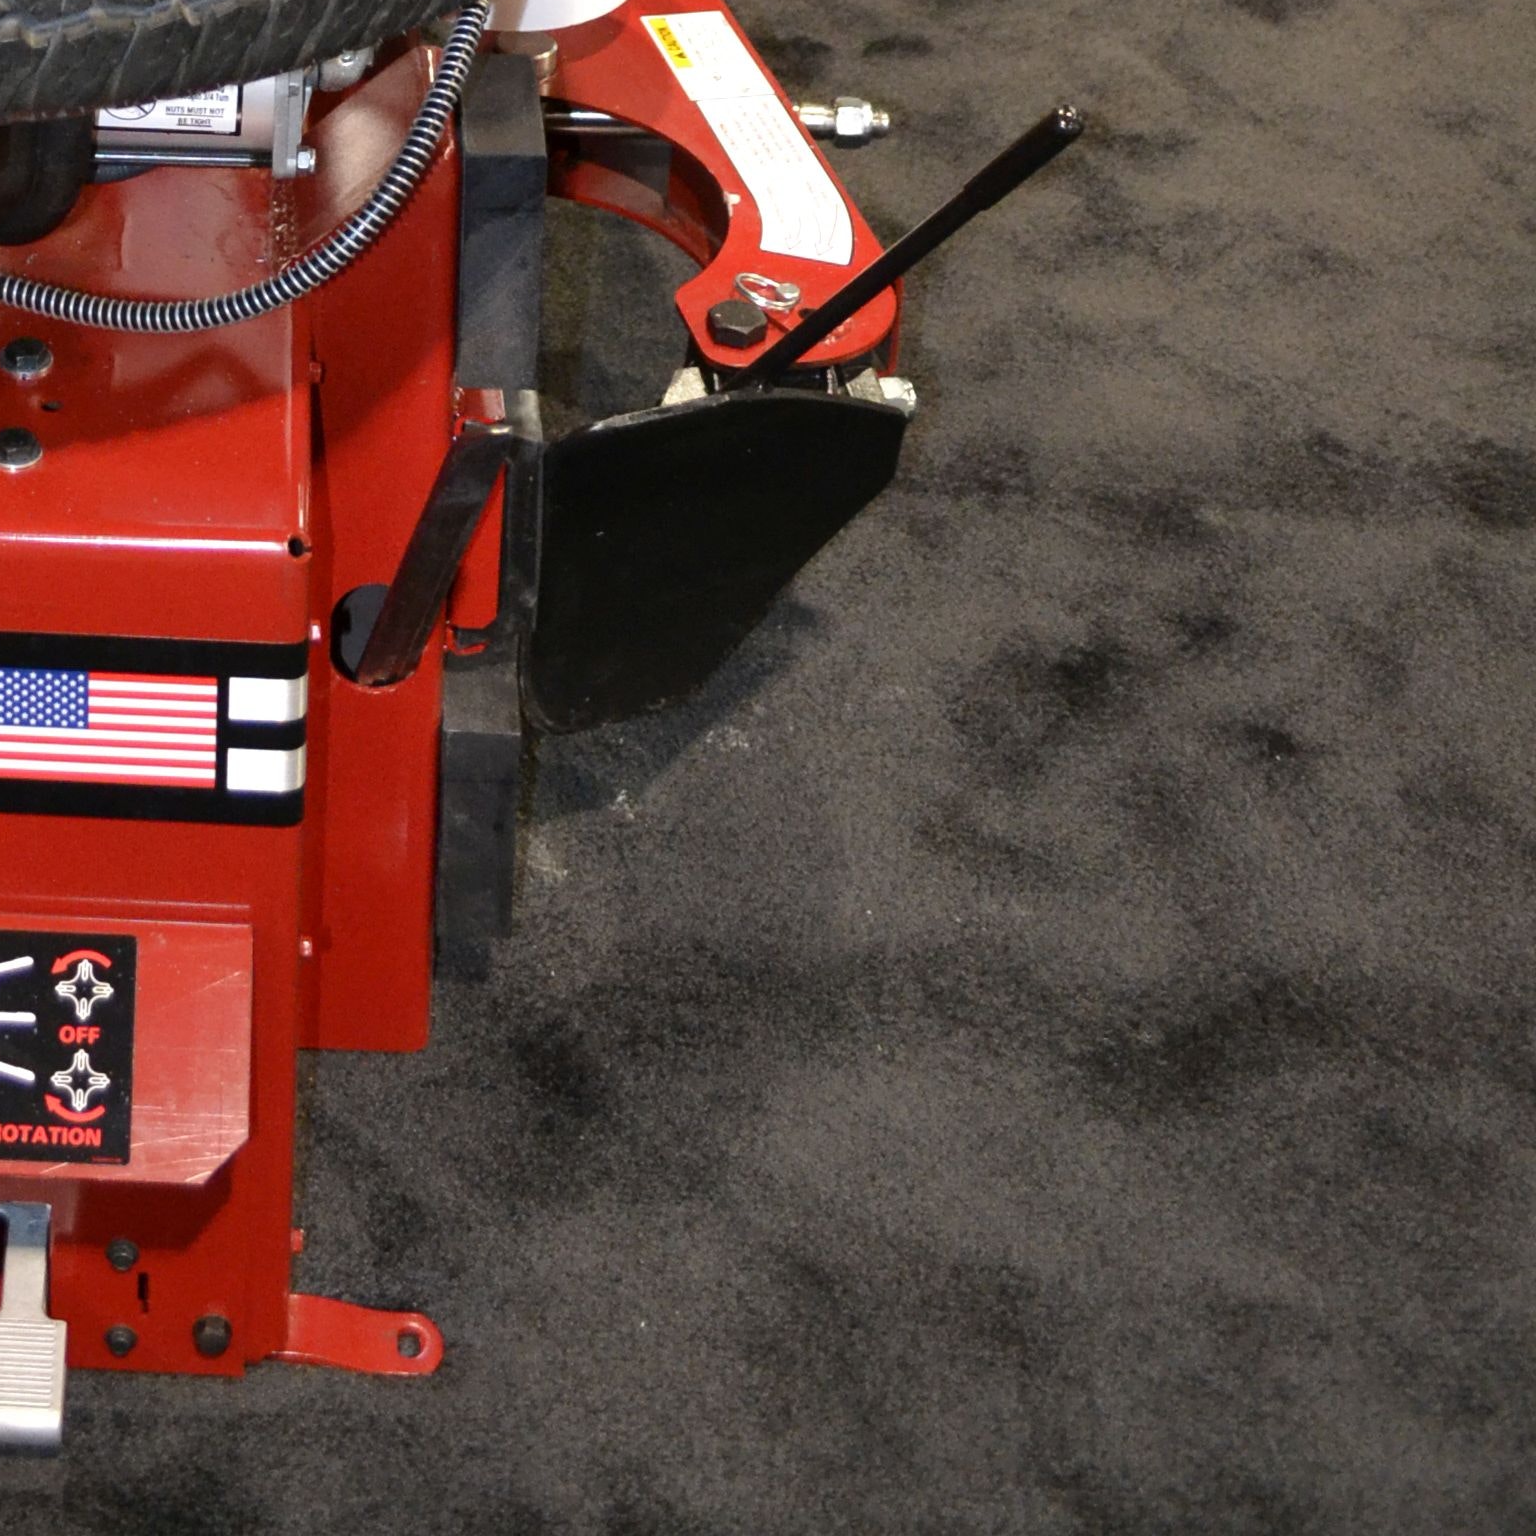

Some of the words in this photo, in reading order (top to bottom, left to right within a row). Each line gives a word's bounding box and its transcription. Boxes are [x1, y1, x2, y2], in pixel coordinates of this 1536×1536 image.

[165, 106, 185, 114] NUTS
[187, 107, 207, 115] MUST
[58, 1025, 101, 1045] OFF
